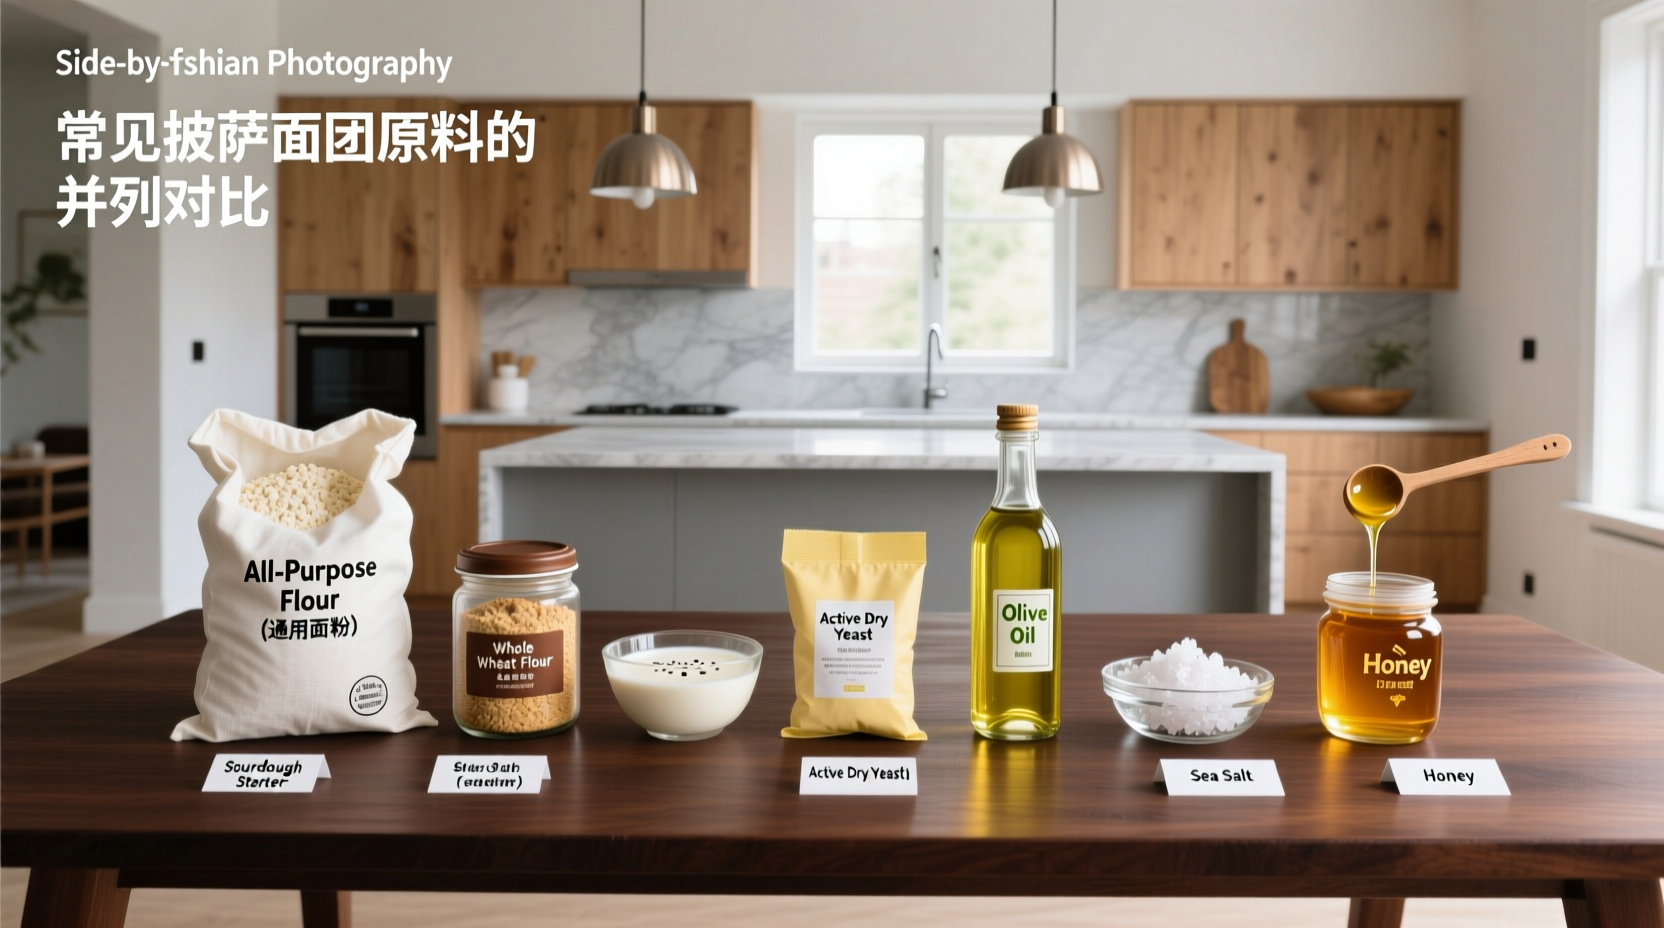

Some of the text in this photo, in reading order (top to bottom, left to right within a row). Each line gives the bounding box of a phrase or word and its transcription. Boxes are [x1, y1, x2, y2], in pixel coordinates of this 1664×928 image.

[244, 559, 377, 586] All-Purpose
[281, 589, 340, 612] Flour
[820, 612, 888, 628] Active Dry
[1002, 603, 1048, 622] Olive
[834, 627, 873, 641] Yeast
[1010, 626, 1035, 644] Oil
[493, 641, 534, 655] Whole
[477, 656, 553, 669] Wheat Flour
[1363, 652, 1432, 681] Honey
[224, 759, 302, 777] Sourdough
[809, 765, 844, 779] Active
[847, 766, 869, 782] Dry
[1190, 768, 1254, 782] Sea Salt
[236, 776, 289, 788] Starter
[1423, 768, 1475, 786] Honey
